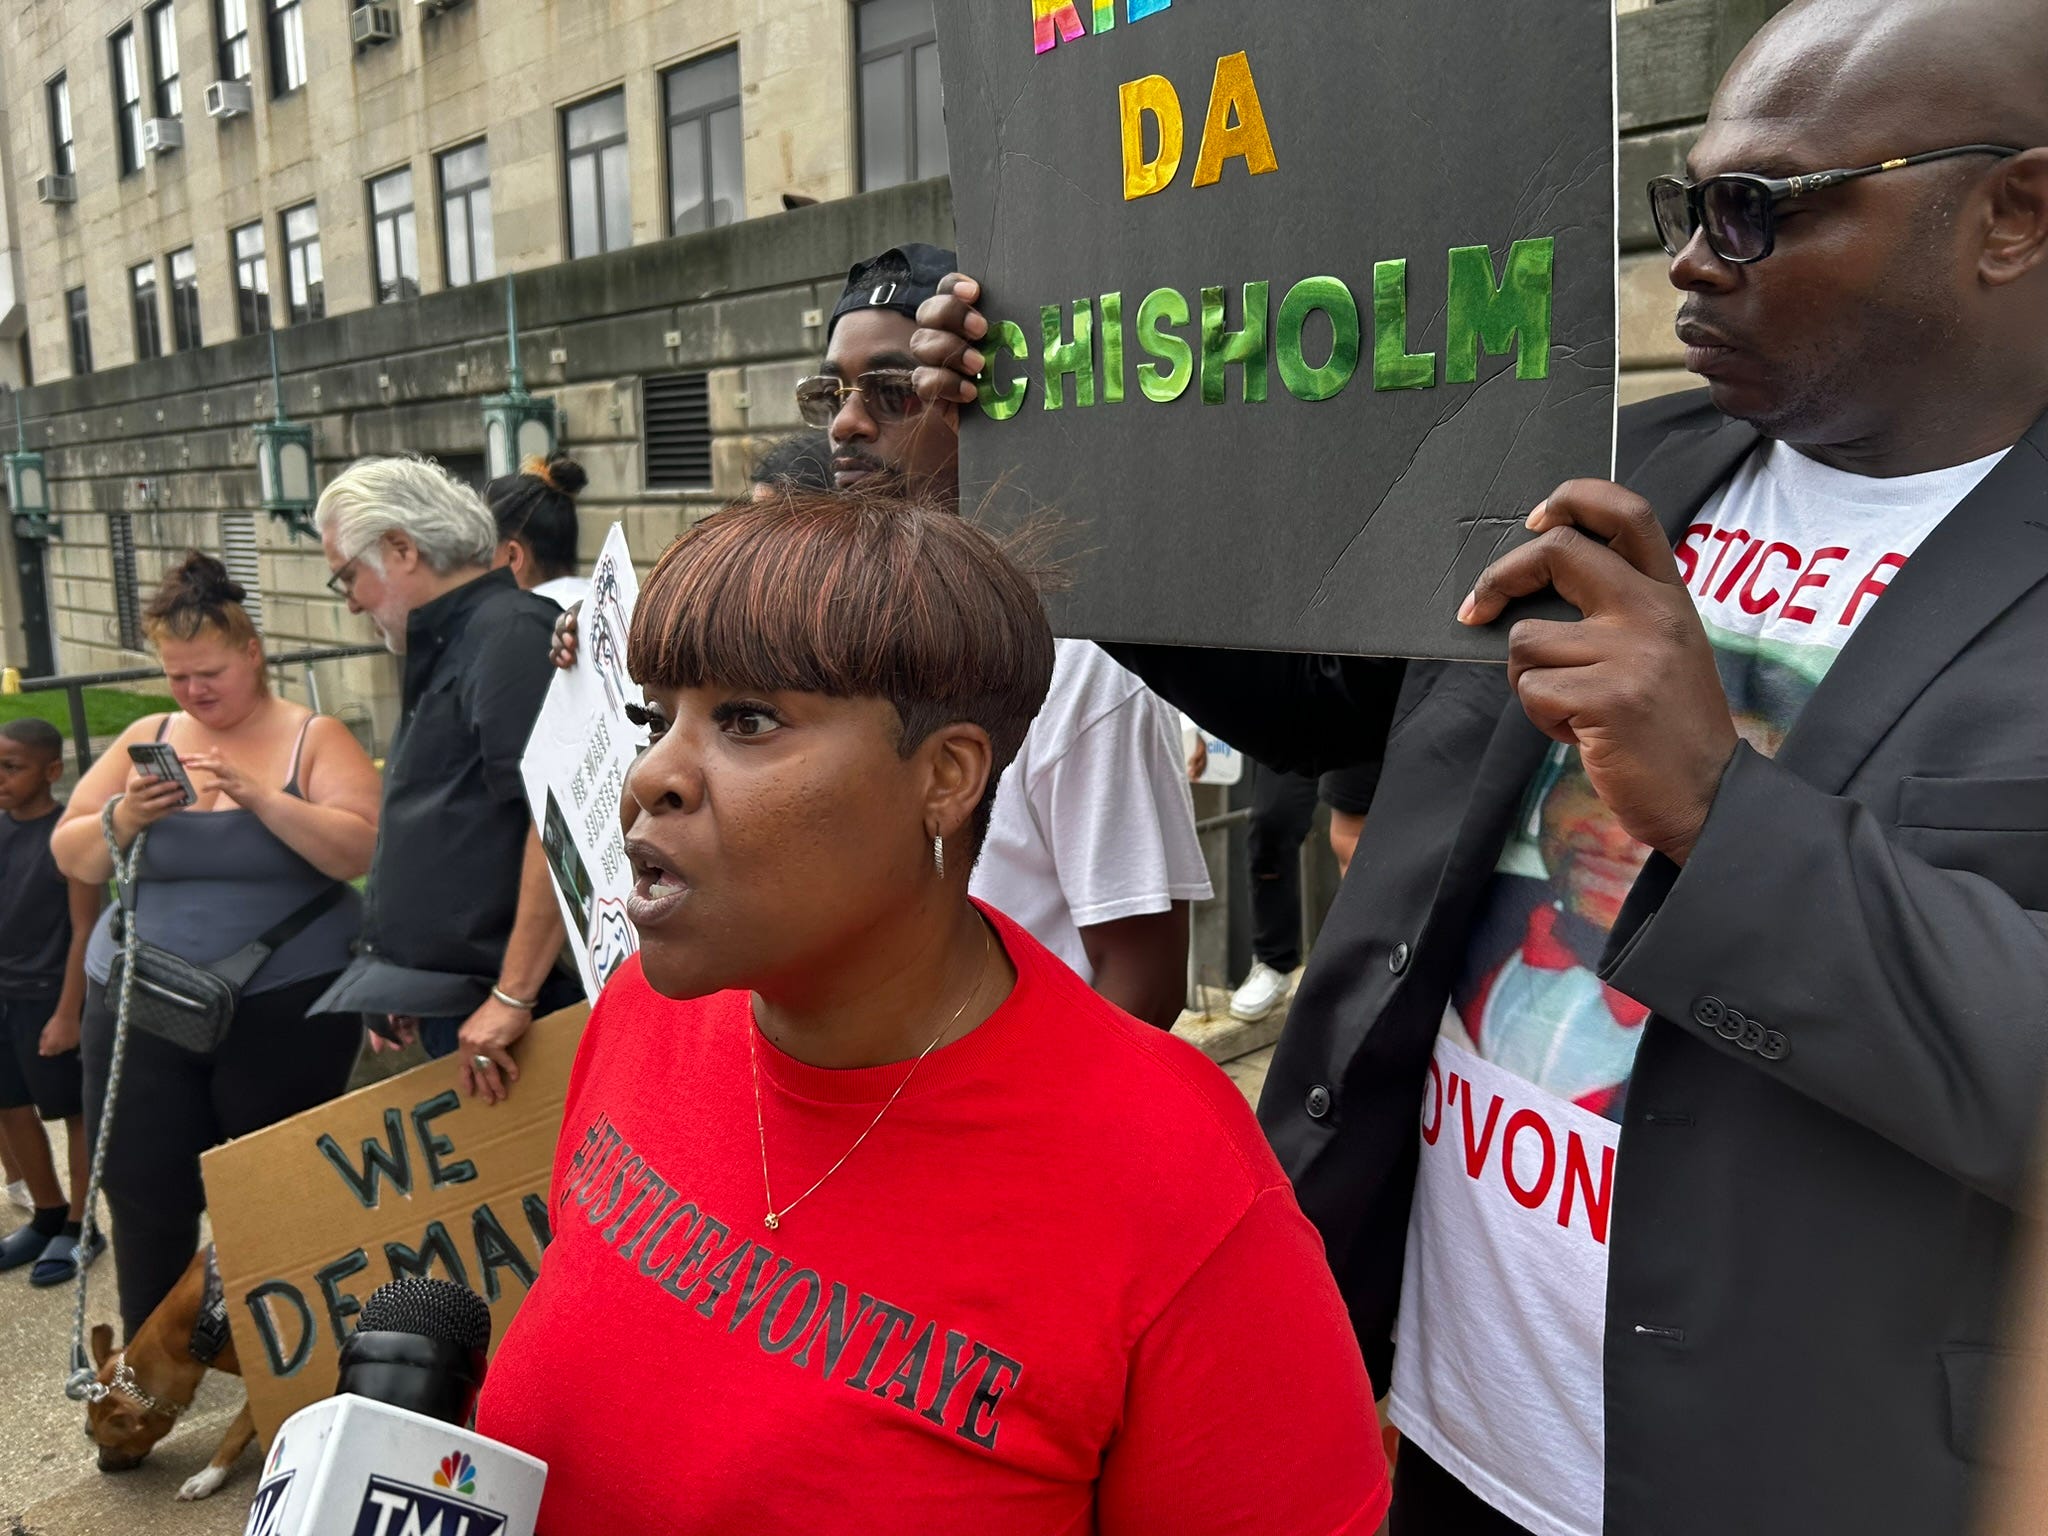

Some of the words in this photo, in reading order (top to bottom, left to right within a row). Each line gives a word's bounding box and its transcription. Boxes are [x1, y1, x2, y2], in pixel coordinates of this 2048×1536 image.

[1119, 50, 1278, 201] DA
[977, 236, 1555, 420] CHISHOLM
[316, 1089, 479, 1209] WE
[560, 1111, 1023, 1450] #JUSTICE4VONTAYE
